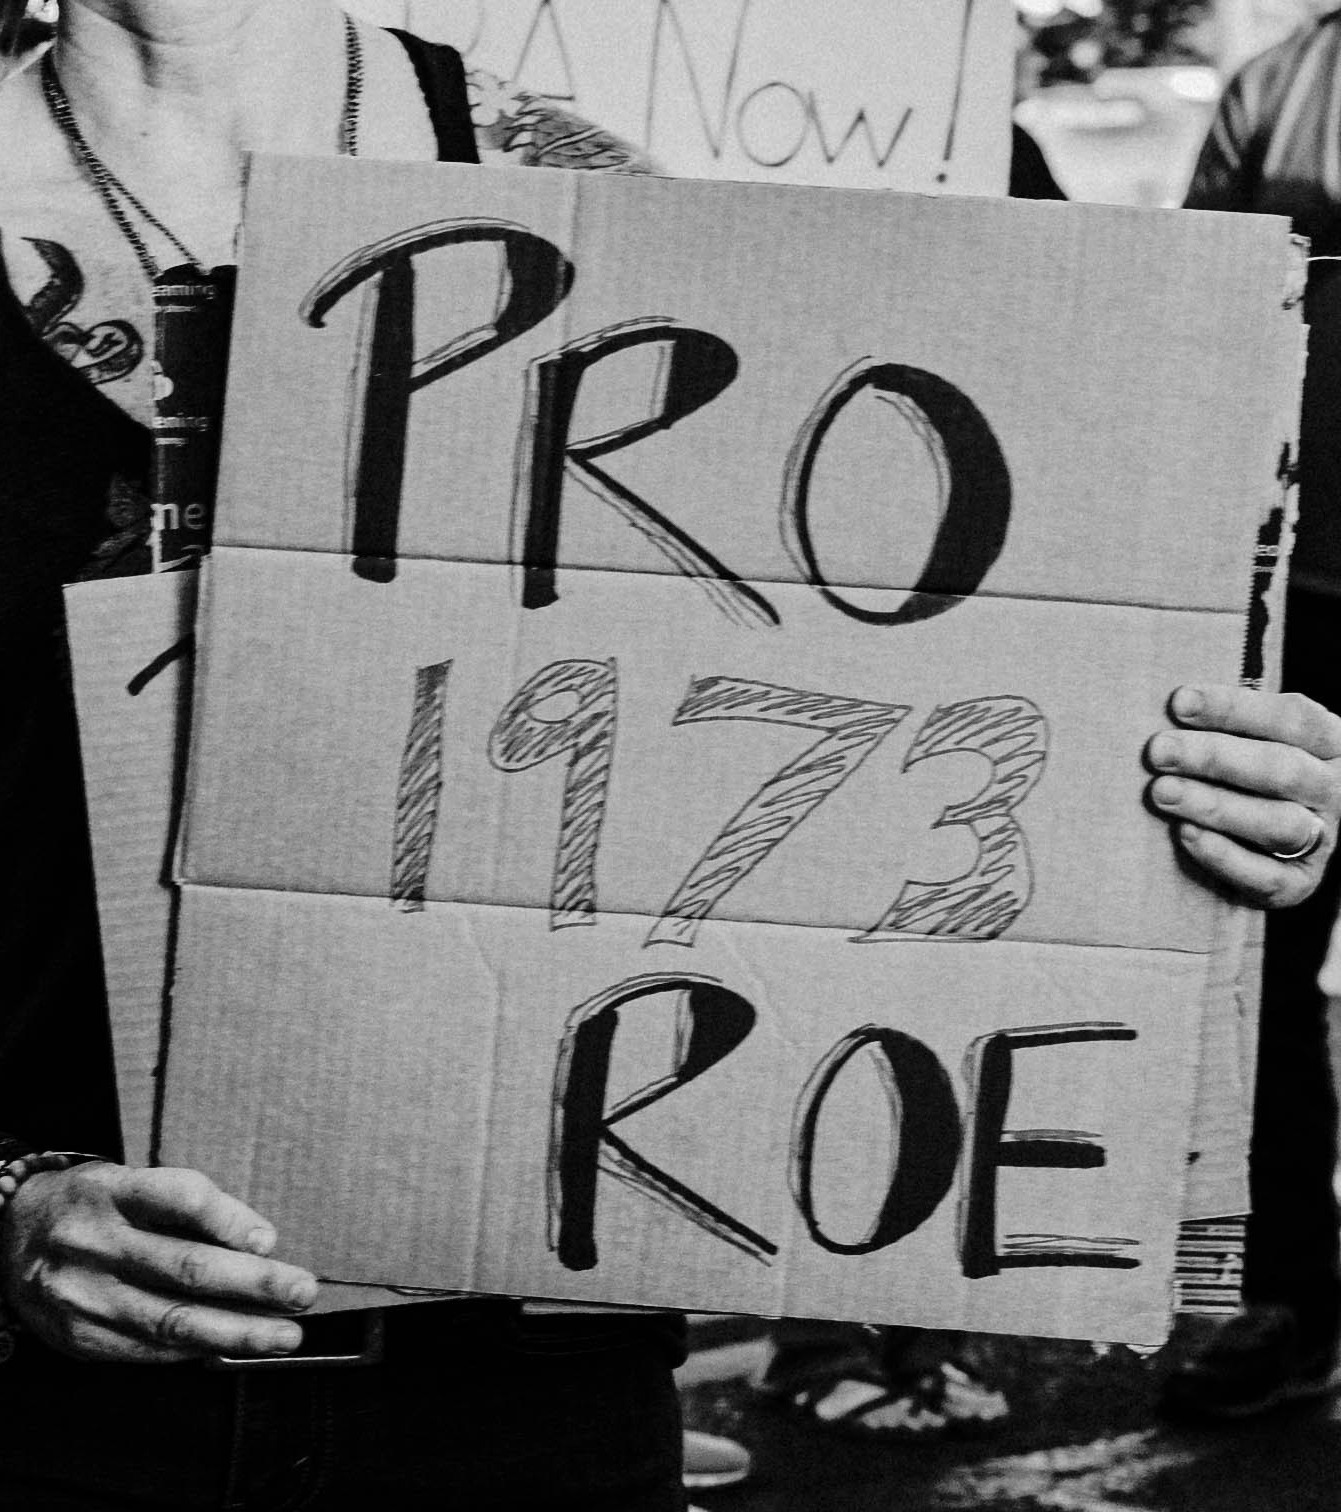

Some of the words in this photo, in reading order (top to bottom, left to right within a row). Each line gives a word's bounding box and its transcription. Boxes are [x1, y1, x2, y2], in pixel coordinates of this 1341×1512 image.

[298, 216, 1014, 628] PRO
[392, 657, 1052, 950] 1973
[546, 970, 1141, 1280] ROE
